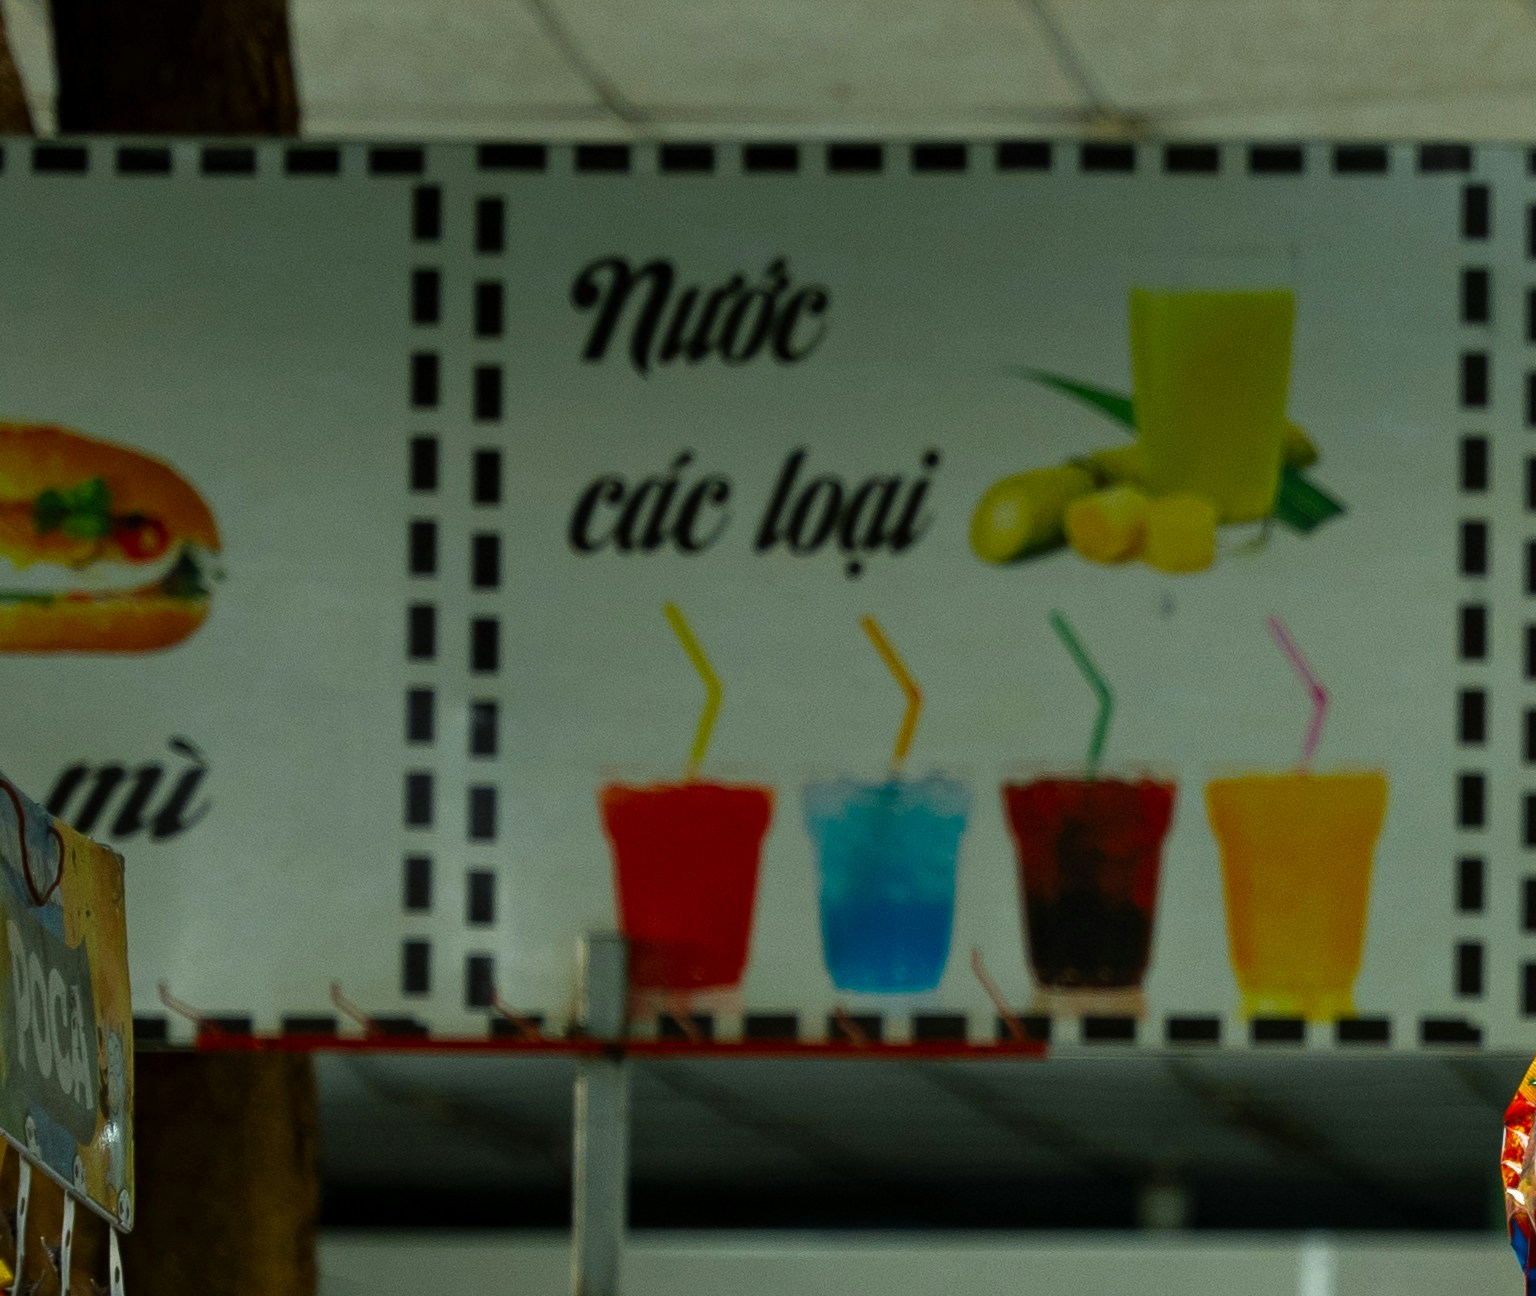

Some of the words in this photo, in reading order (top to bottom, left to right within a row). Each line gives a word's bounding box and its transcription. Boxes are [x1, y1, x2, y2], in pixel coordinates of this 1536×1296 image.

[570, 254, 829, 378] Nước
[567, 447, 733, 557] các
[752, 445, 941, 580] loại
[6, 918, 94, 1110] POCA
